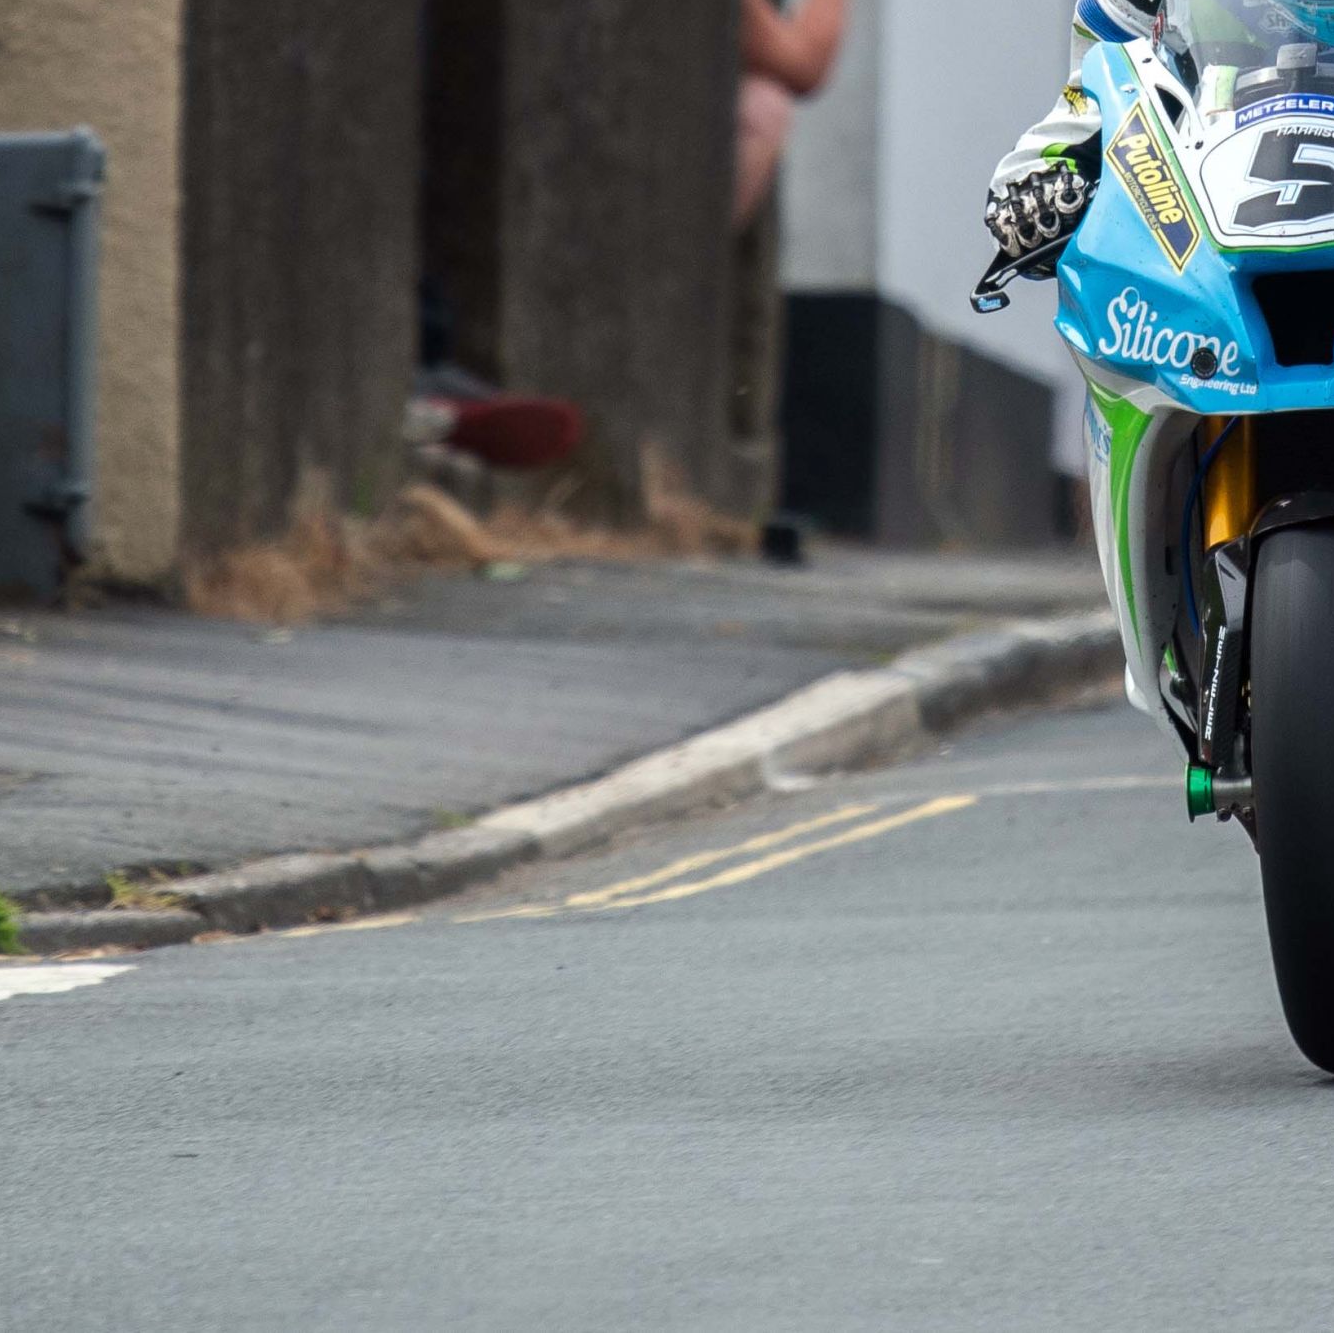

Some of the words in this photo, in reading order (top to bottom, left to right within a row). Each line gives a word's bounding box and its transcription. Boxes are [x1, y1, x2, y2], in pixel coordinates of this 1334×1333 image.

[1117, 133, 1185, 225] Putoline
[1098, 286, 1240, 377] Silicone
[1179, 373, 1240, 395] Engineering
[1239, 382, 1258, 395] Ltd
[1204, 625, 1227, 741] METZELER
